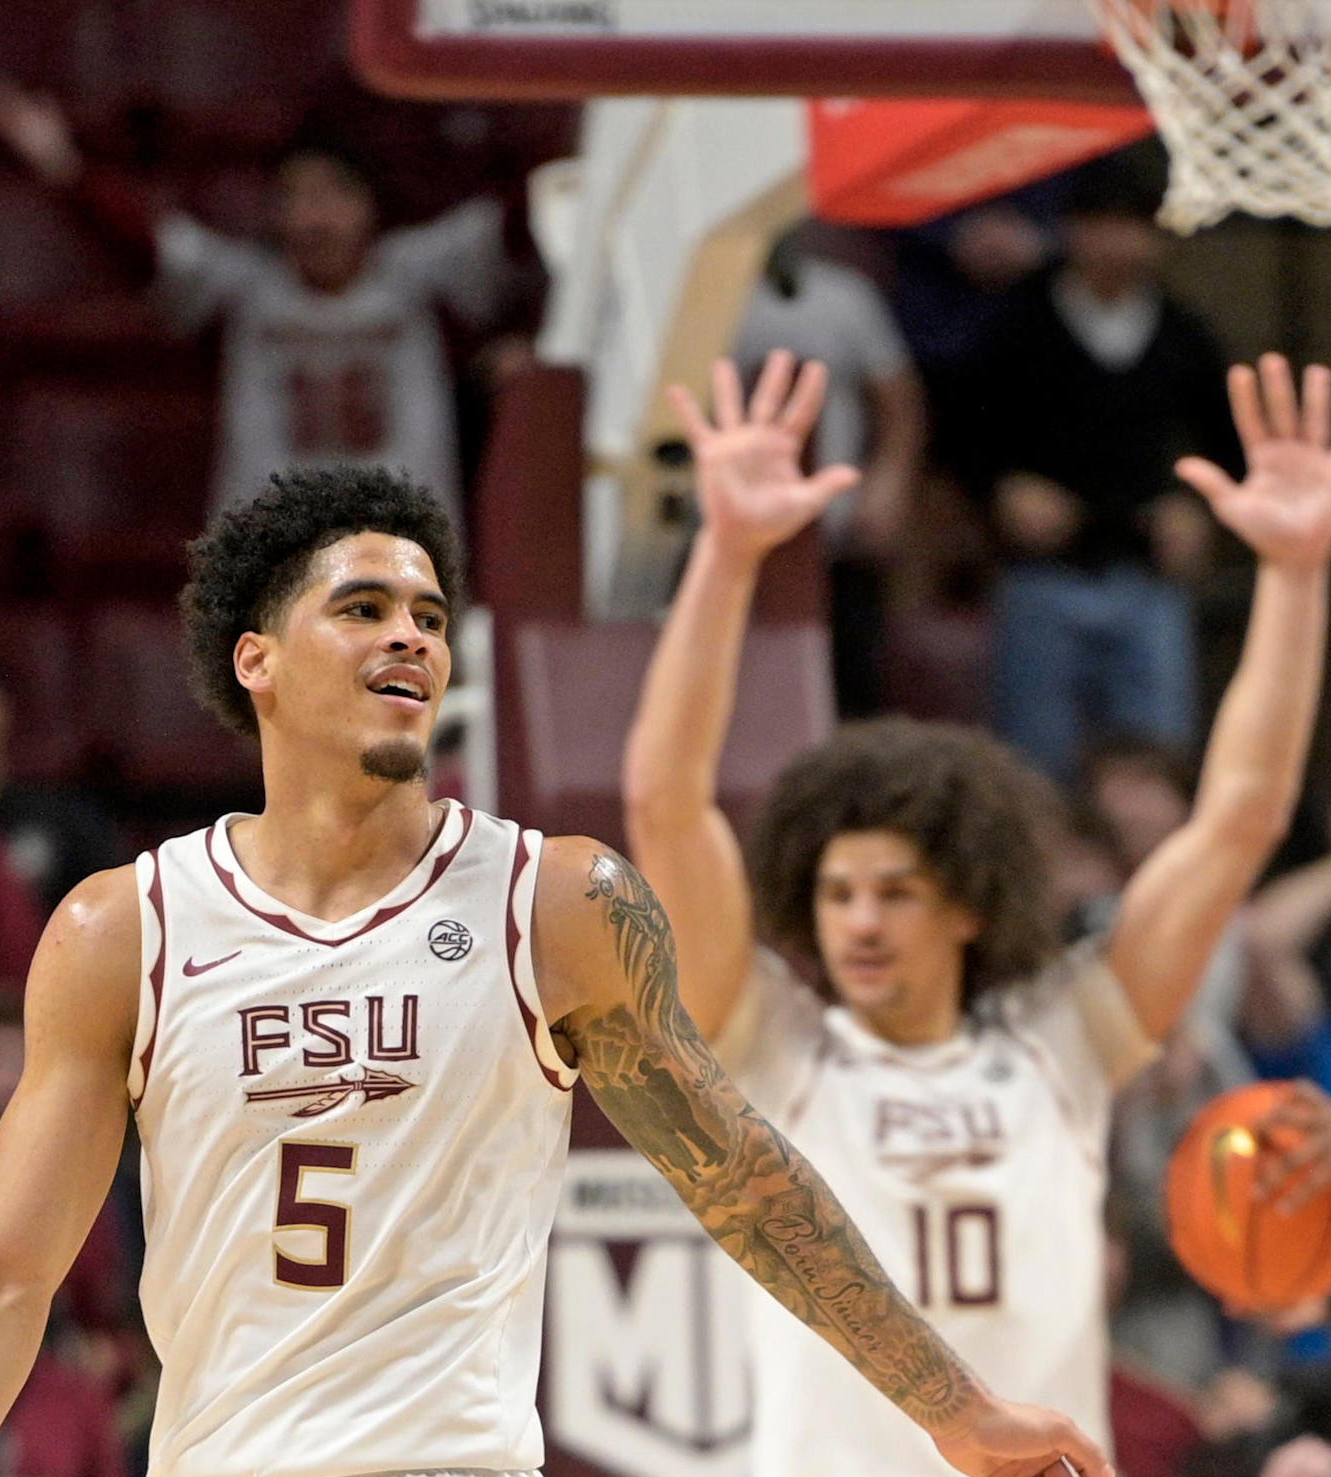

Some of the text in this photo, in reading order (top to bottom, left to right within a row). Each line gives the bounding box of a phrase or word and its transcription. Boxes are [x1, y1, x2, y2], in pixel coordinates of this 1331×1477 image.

[433, 932, 469, 945] ACC
[238, 994, 421, 1077] FSU
[874, 1097, 1003, 1145] FSU
[272, 1138, 360, 1292] 5
[761, 1213, 818, 1283] Born
[911, 1201, 1001, 1309] 10
